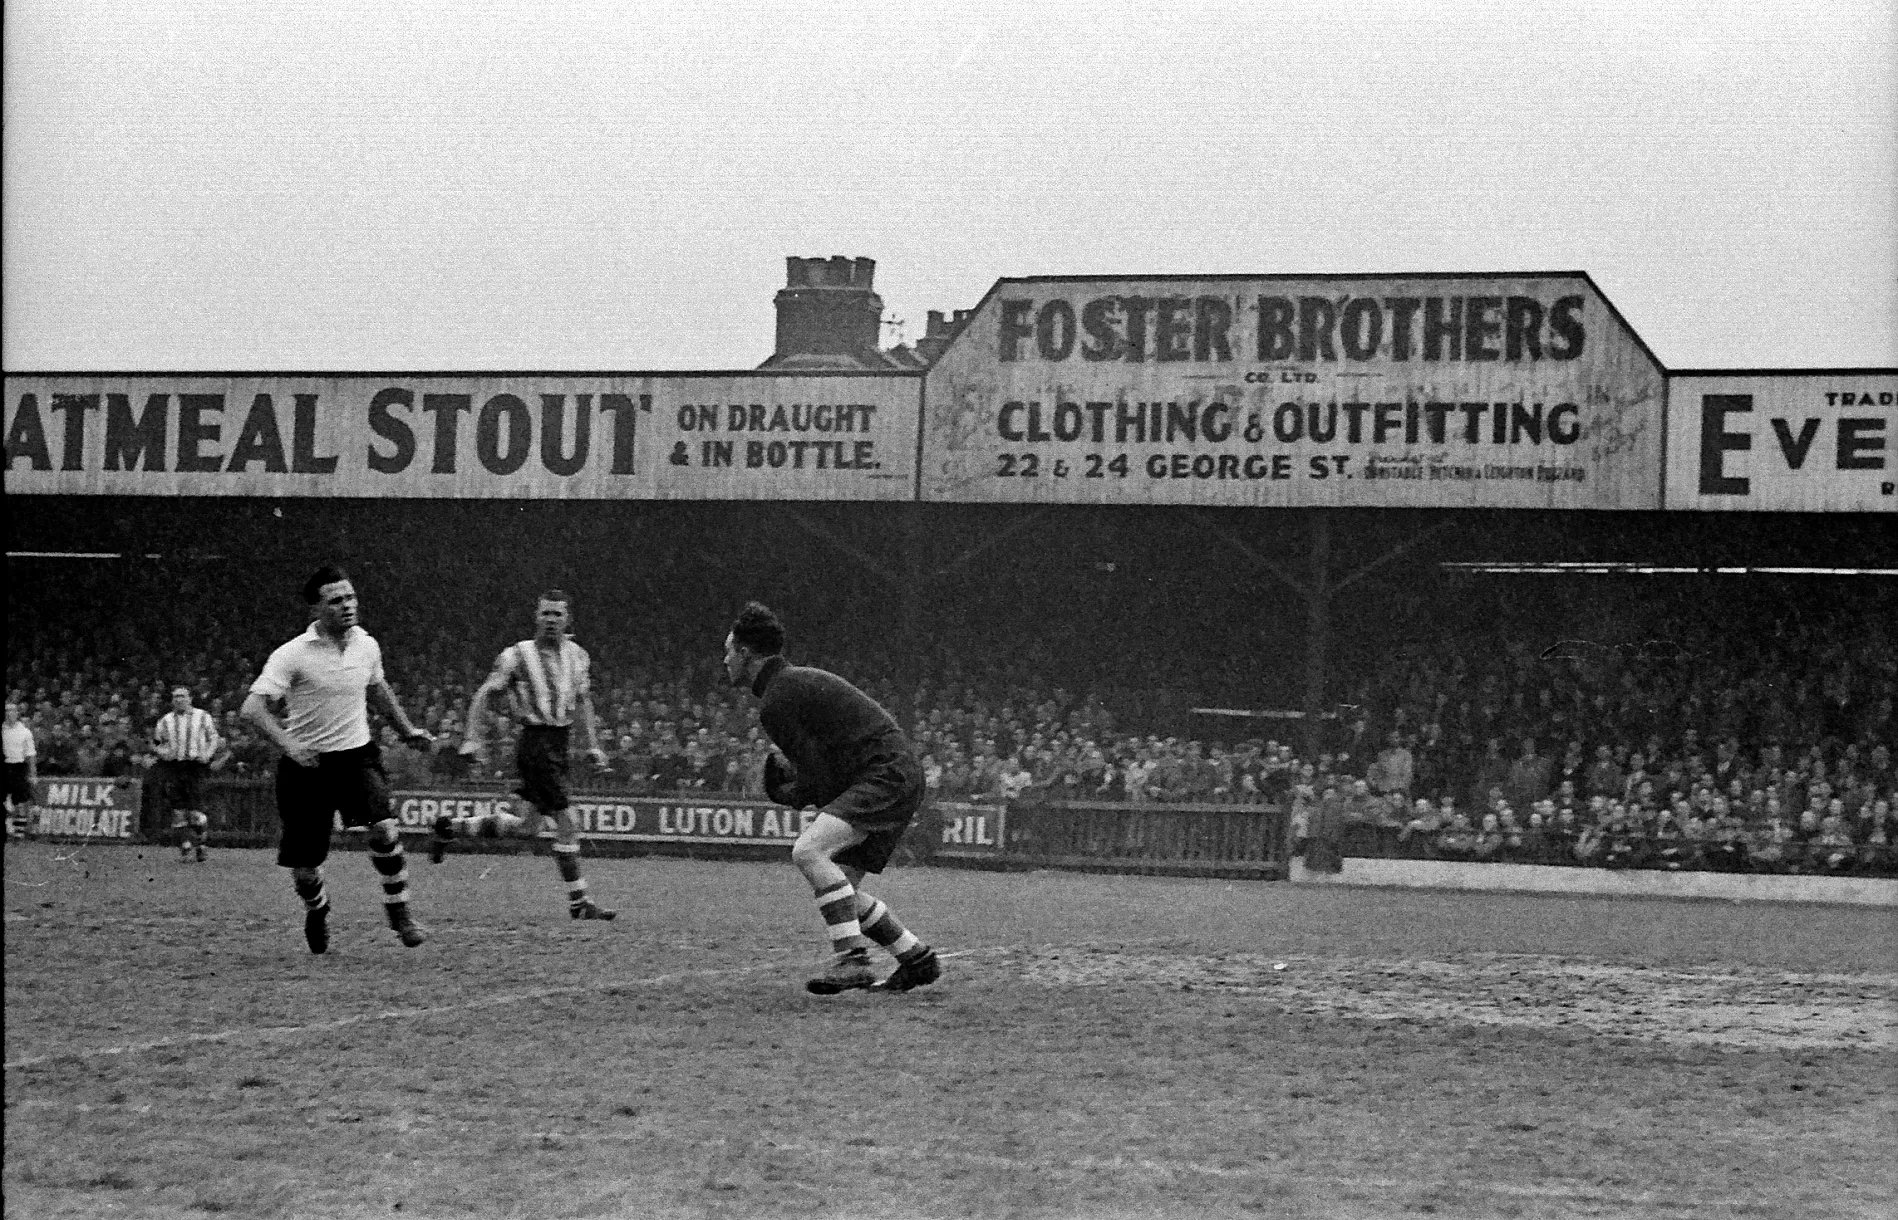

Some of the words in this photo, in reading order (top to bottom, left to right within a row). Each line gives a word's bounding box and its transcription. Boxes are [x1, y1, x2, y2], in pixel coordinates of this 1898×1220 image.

[999, 295, 1234, 362] FOSTER
[1257, 294, 1587, 362] BROTHERS
[1824, 391, 1898, 407] TRAD
[4, 392, 339, 474] ATMEAL
[367, 387, 653, 476] STOUT
[676, 404, 718, 432] ON
[727, 404, 877, 432] DRAUGHT
[997, 400, 1233, 444] CLOTHING
[1243, 412, 1265, 444] &
[1272, 401, 1581, 446] OUTFITTING
[668, 440, 690, 467] &
[701, 440, 735, 468] IN
[745, 440, 882, 470] BOTTLE.
[1698, 394, 1887, 496] EVE
[996, 453, 1039, 478] 22
[1053, 459, 1070, 478] &
[1085, 453, 1129, 479] 24
[1146, 453, 1292, 480] GEORGE
[1308, 454, 1353, 480] ST.
[47, 783, 115, 807] MILK
[658, 807, 753, 837] LUTON
